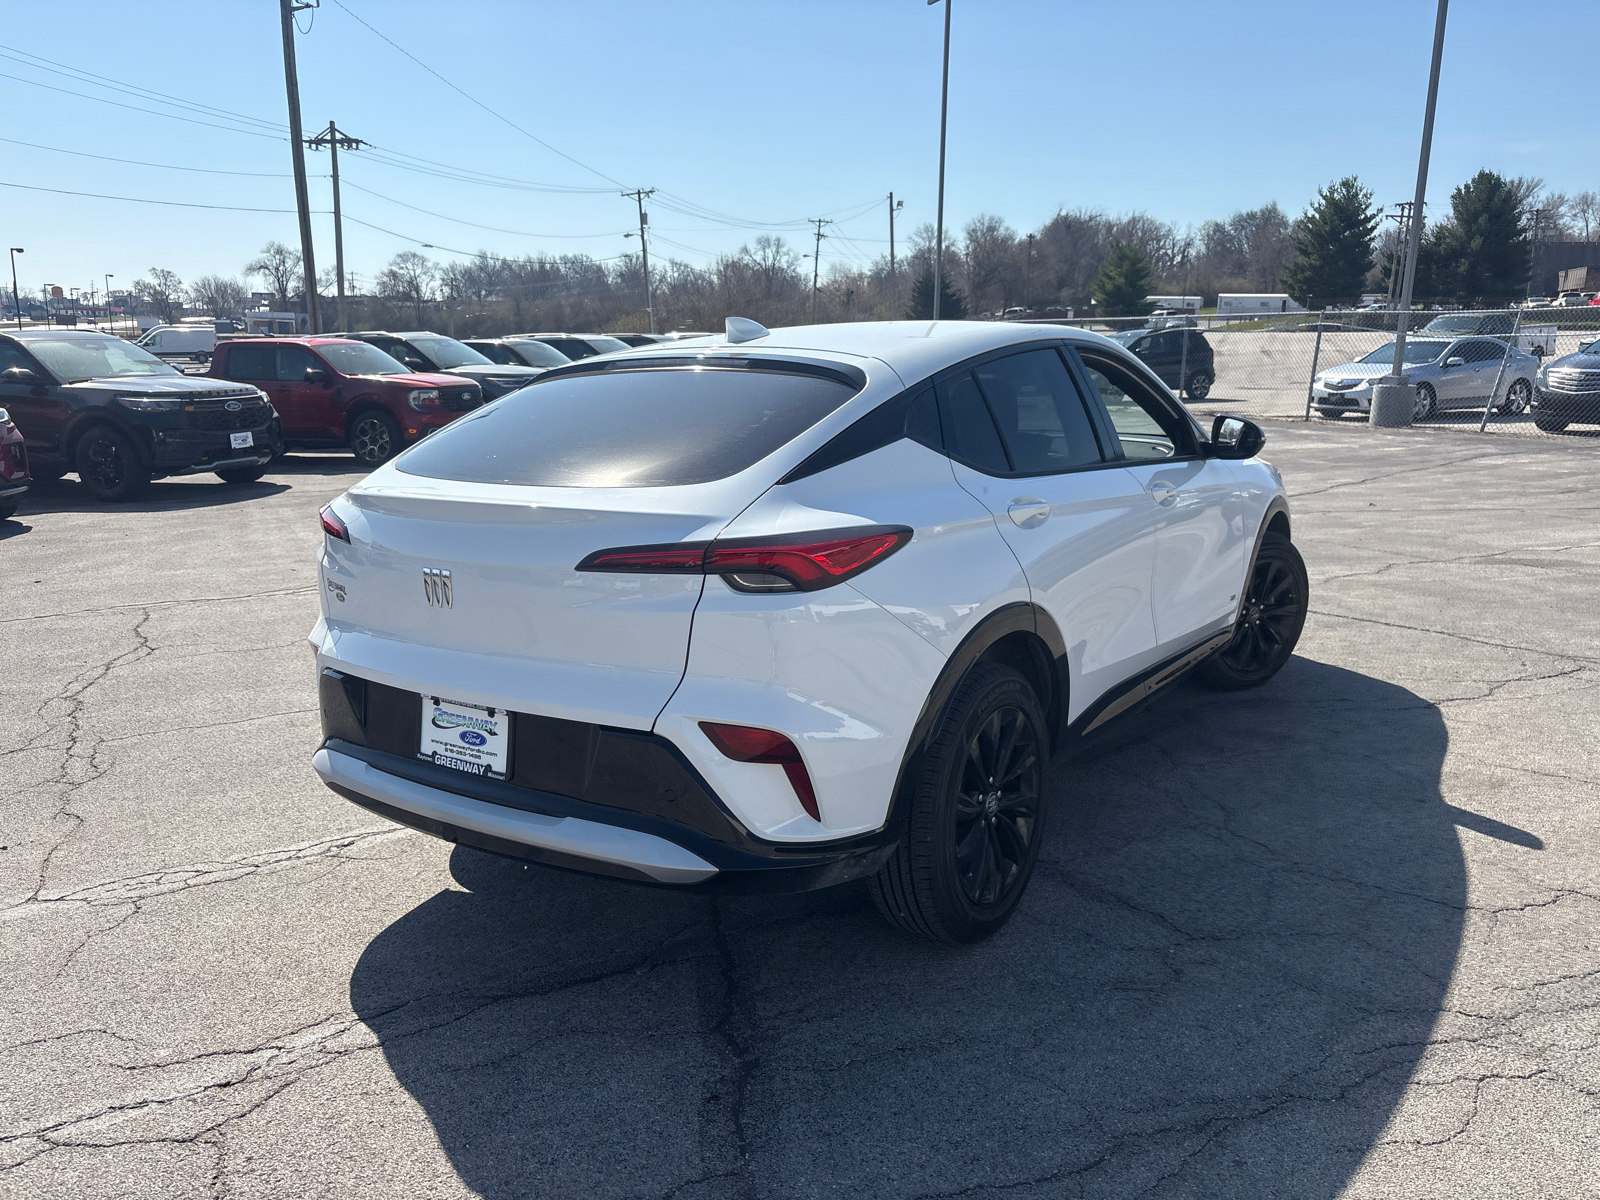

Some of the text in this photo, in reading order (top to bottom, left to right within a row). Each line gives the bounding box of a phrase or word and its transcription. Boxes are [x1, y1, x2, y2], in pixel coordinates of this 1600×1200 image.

[433, 706, 498, 733] GREENWAY
[430, 738, 498, 758] www.greenwayfordkc.com
[463, 731, 483, 745] Ford
[434, 754, 486, 776] GREENWAY
